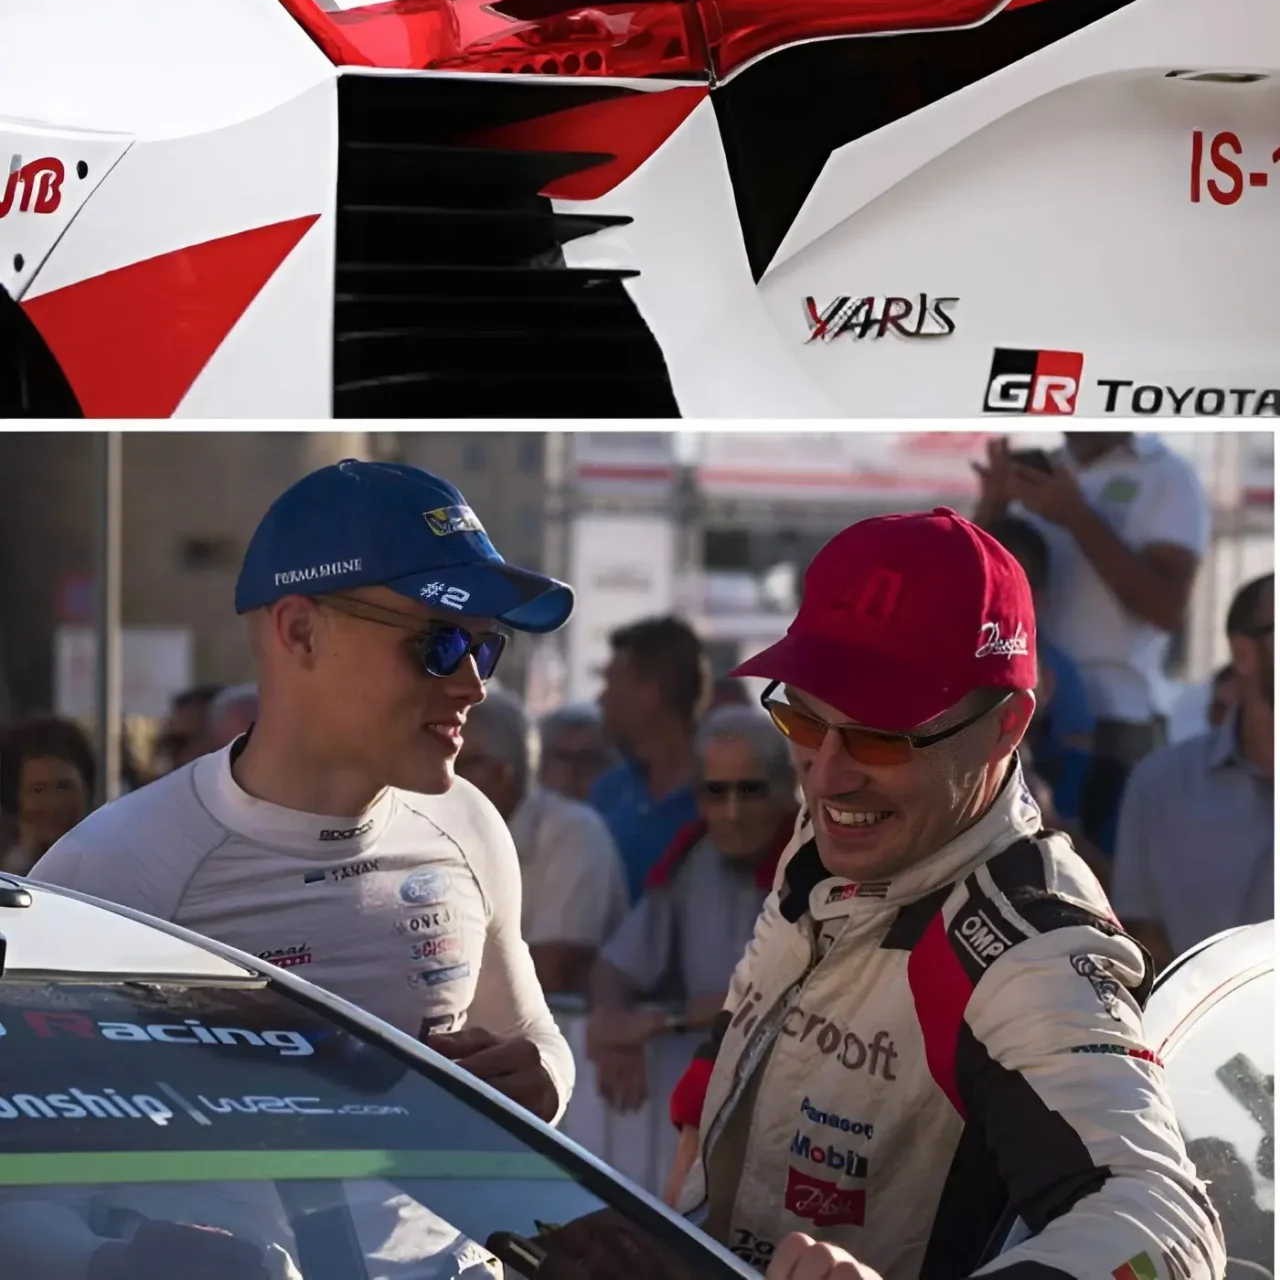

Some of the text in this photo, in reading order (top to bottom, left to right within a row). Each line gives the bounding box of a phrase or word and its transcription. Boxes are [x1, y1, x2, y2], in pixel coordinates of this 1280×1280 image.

[803, 293, 961, 345] YARIS
[961, 916, 1005, 959] OMP
[22, 1011, 315, 1056] Racing
